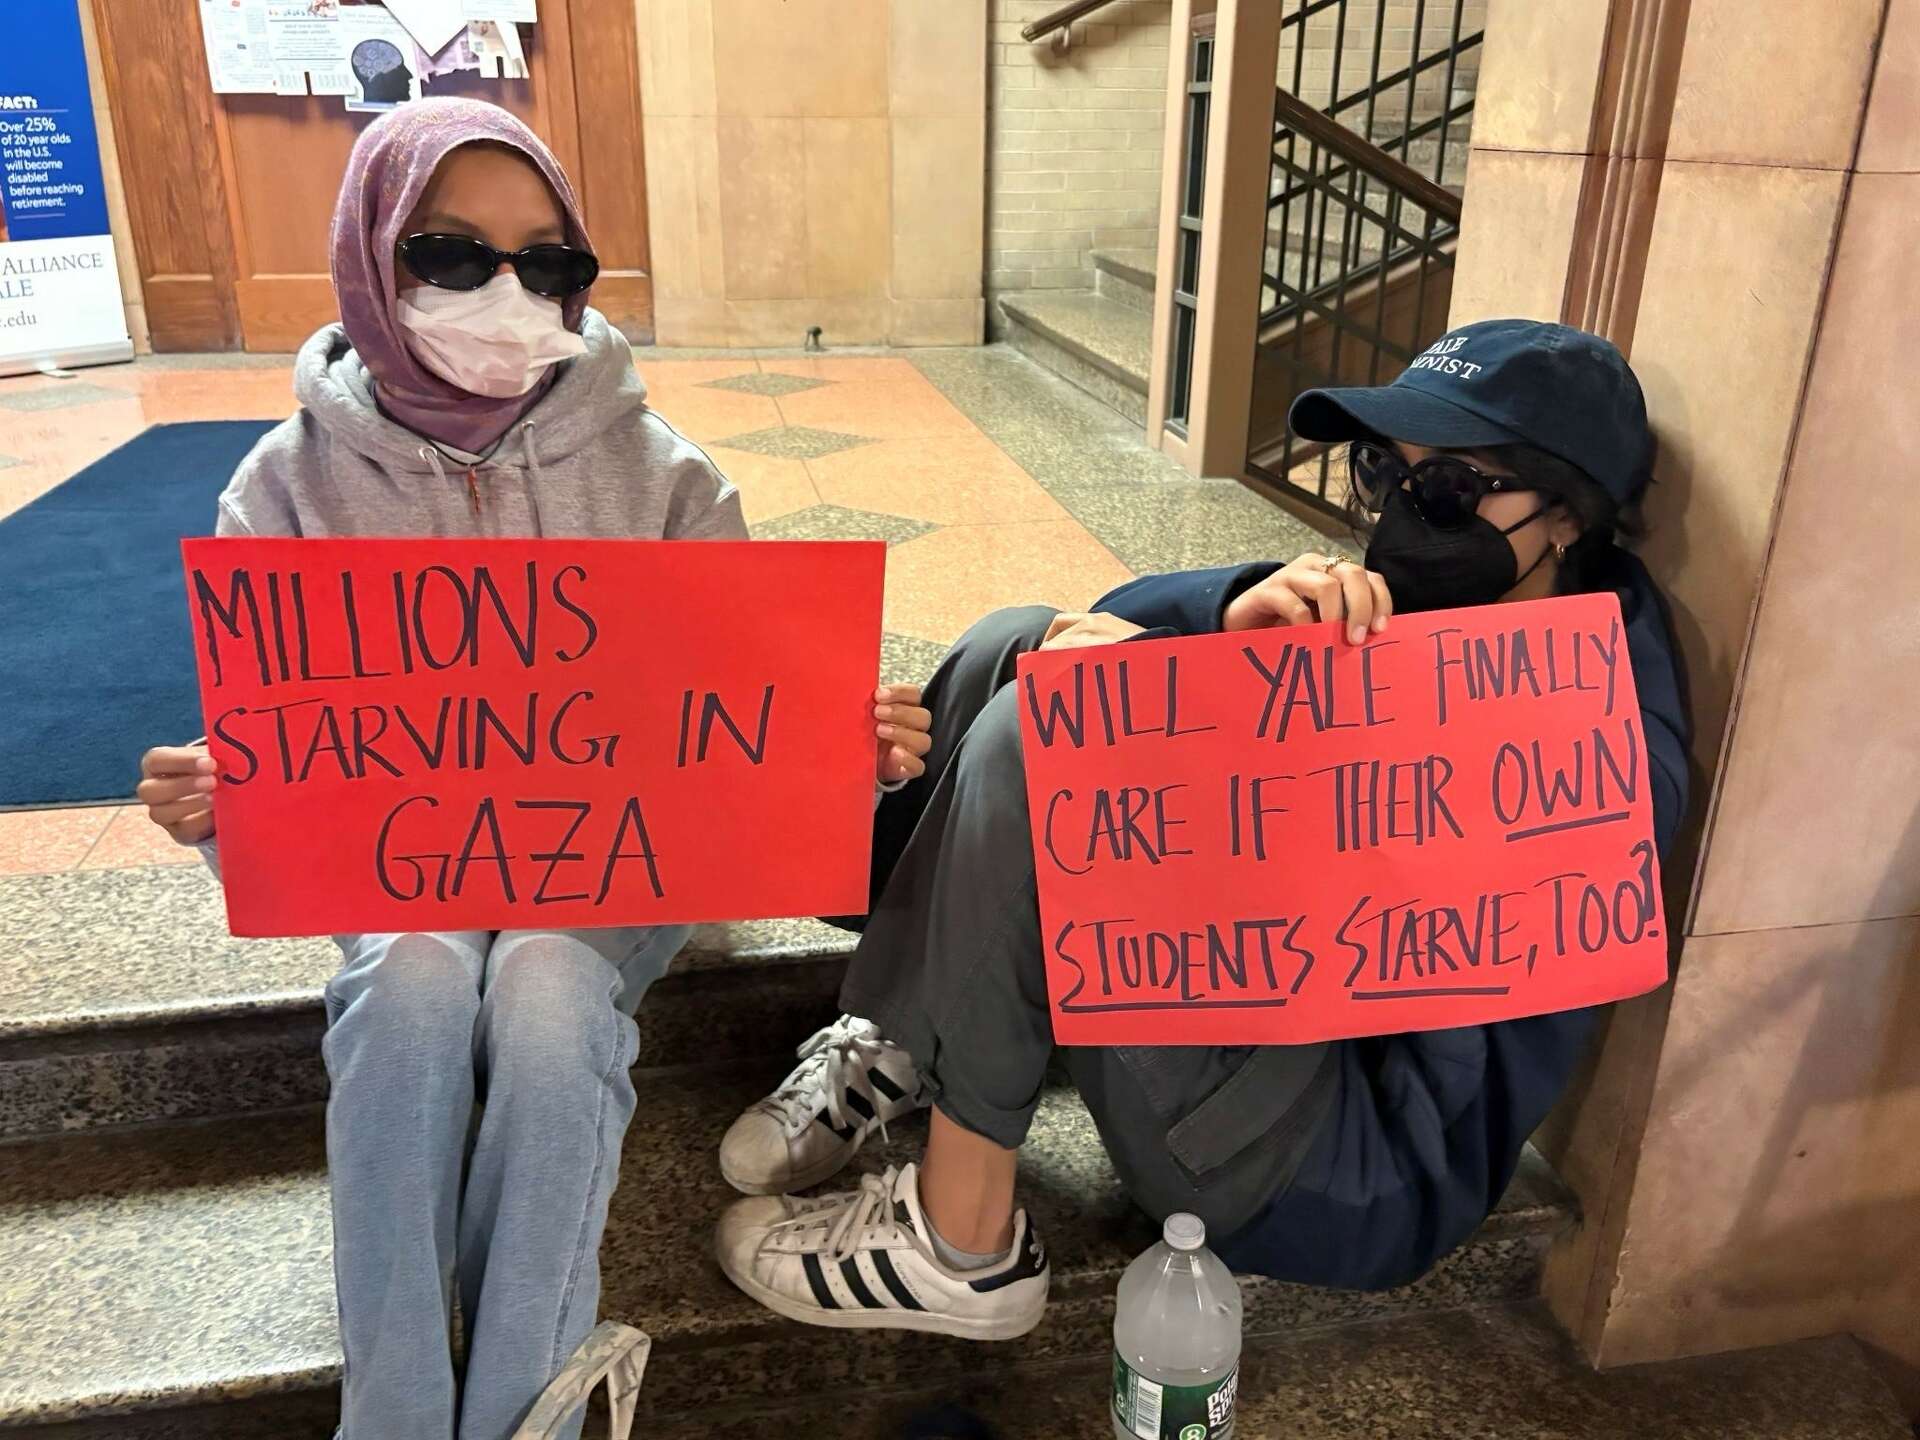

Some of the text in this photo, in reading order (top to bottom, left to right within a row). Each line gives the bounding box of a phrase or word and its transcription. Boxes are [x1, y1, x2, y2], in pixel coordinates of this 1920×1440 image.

[0, 117, 56, 132] Over 25%
[1, 133, 71, 147] of 20 year olds
[3, 146, 52, 159] in the U.S.
[5, 159, 63, 171] will become
[8, 172, 48, 184] disabled
[9, 183, 84, 197] before reaching
[12, 197, 66, 210] retirement.
[3, 252, 104, 276] ALLIANCE
[1423, 336, 1469, 355] ALE
[192, 560, 598, 687] MILLIONS
[1026, 615, 1619, 749] WILL YALE FINALLY
[213, 684, 774, 785] STARVING IN
[1044, 719, 1637, 875] CARE IF THEIR OWN
[375, 795, 665, 905] GAZA
[1055, 839, 1661, 1008] STUDENTS STARVE, TOO?
